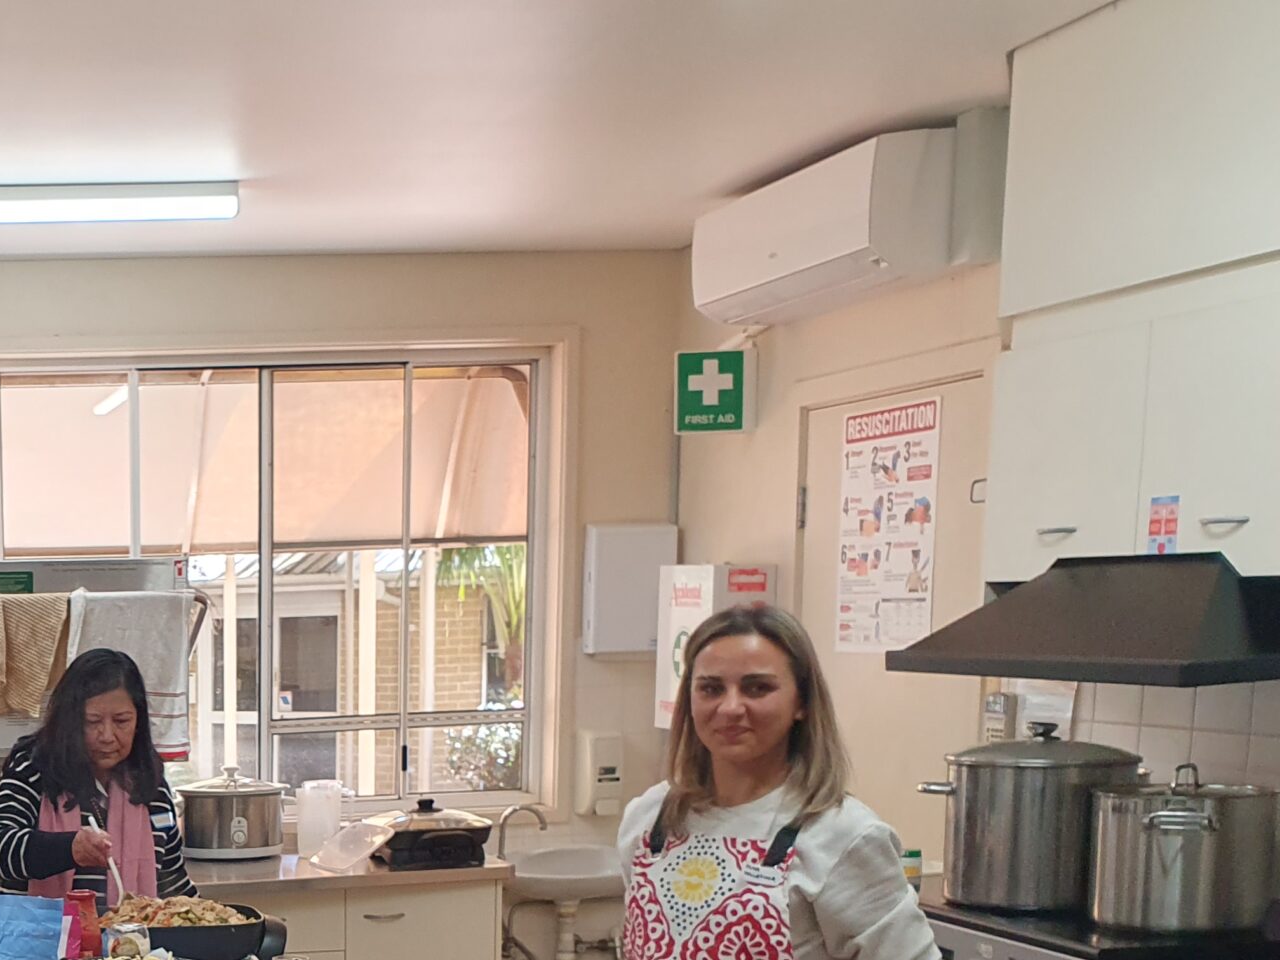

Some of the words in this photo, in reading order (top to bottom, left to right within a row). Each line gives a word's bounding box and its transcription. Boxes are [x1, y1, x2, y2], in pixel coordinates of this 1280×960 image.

[685, 414, 715, 424] FIRST
[717, 412, 736, 424] AID
[847, 403, 935, 440] RESUSCITATION
[844, 450, 850, 470] 1
[871, 446, 879, 466] 2
[904, 441, 911, 462] 3
[843, 496, 849, 516] 4
[887, 491, 894, 512] 5
[841, 544, 848, 564] 6
[885, 541, 892, 562] 7
